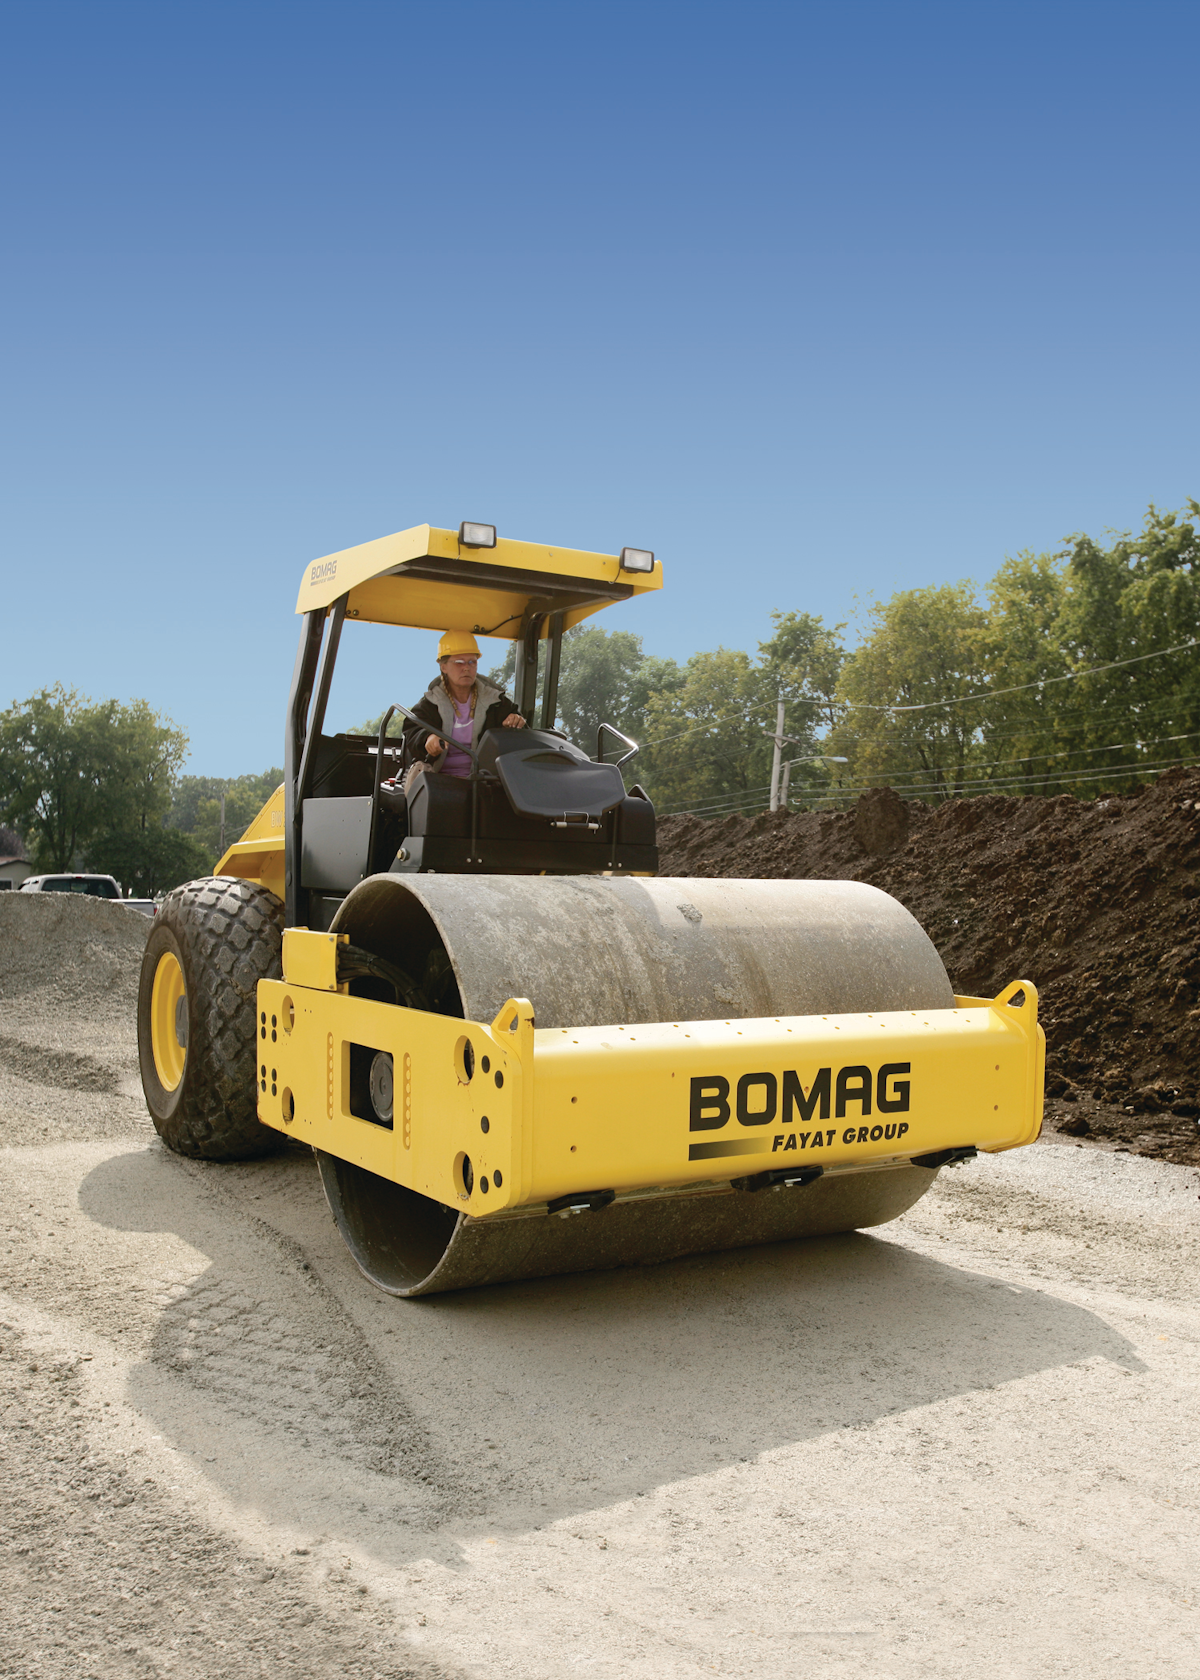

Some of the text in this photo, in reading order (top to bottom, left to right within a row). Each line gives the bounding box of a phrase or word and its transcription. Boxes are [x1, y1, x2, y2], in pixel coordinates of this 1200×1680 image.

[311, 560, 338, 581] BOMAG
[689, 1062, 911, 1132] BOMAG
[772, 1122, 909, 1152] FAYAT GROUP
